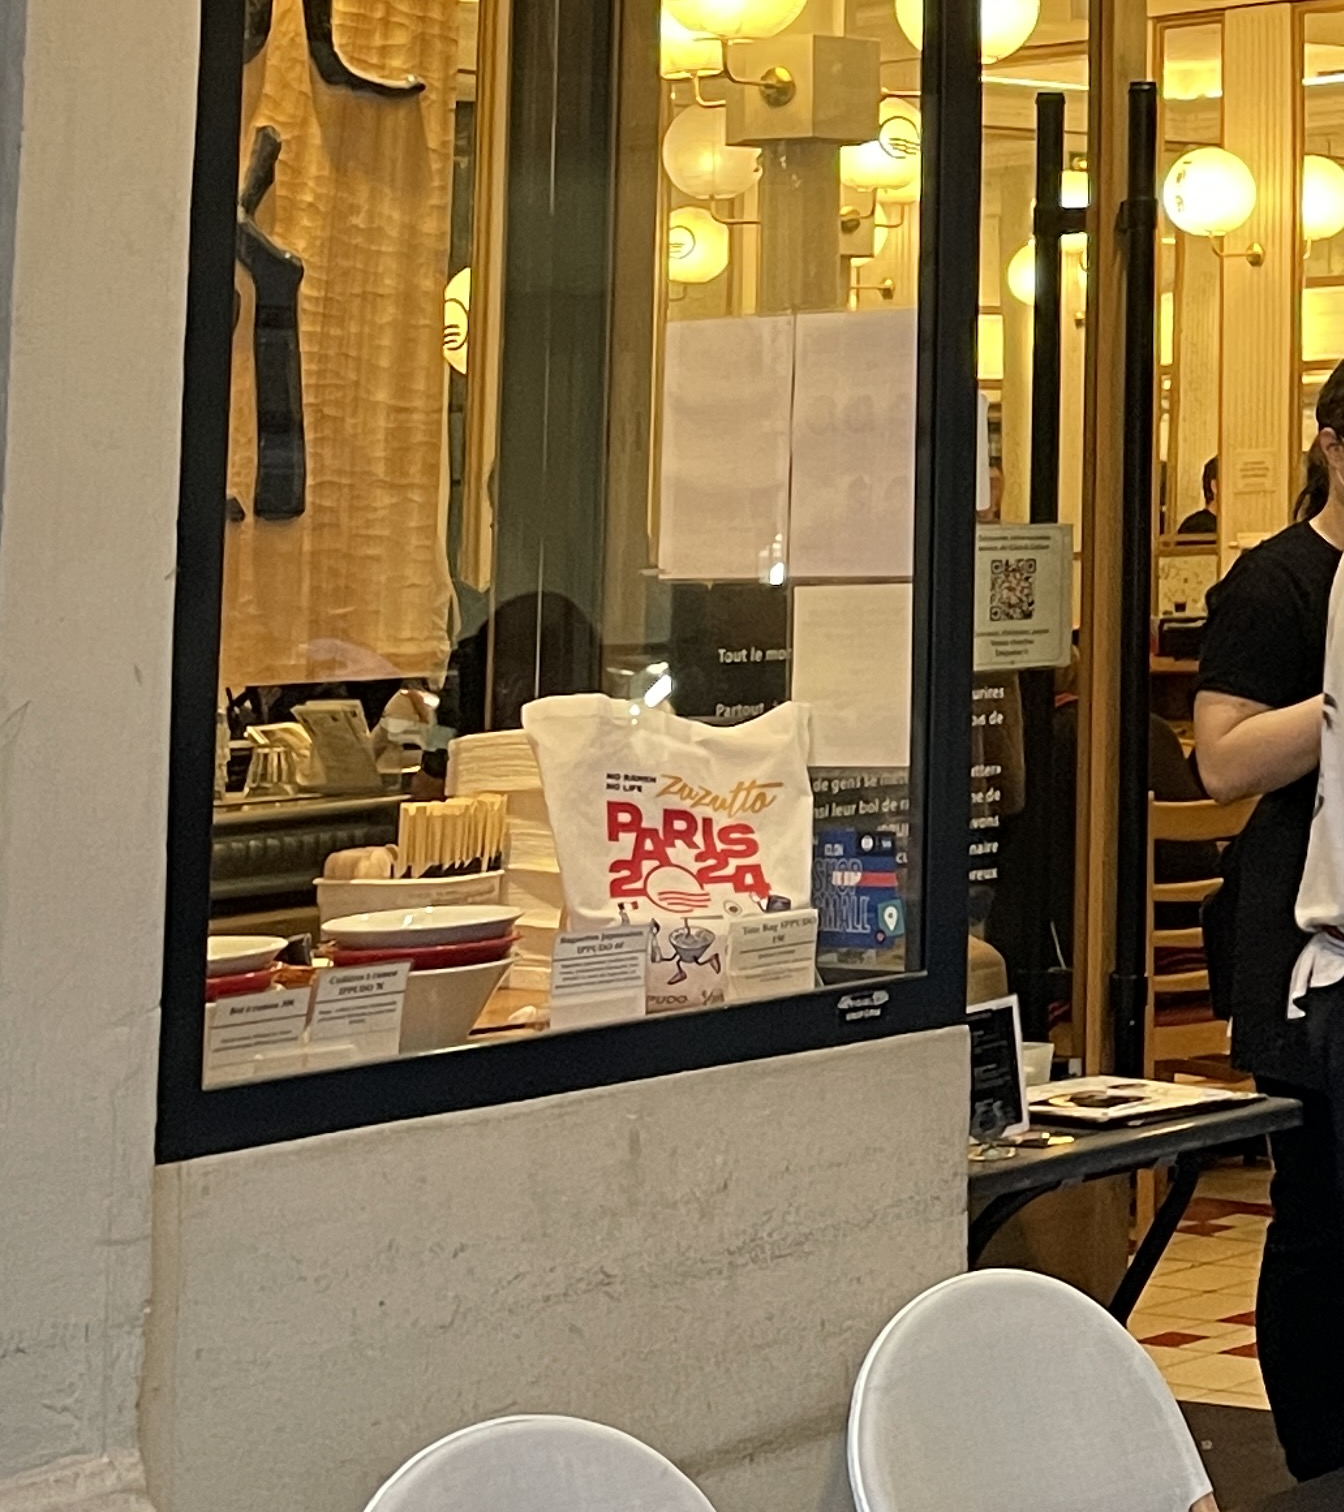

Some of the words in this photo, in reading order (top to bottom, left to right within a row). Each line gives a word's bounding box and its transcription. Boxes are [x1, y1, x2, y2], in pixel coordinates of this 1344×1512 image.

[718, 649, 748, 663] Tout
[750, 647, 762, 662] le
[831, 801, 856, 817] leur
[858, 797, 879, 814] bol
[881, 796, 898, 812] de
[606, 800, 760, 867] PARIS
